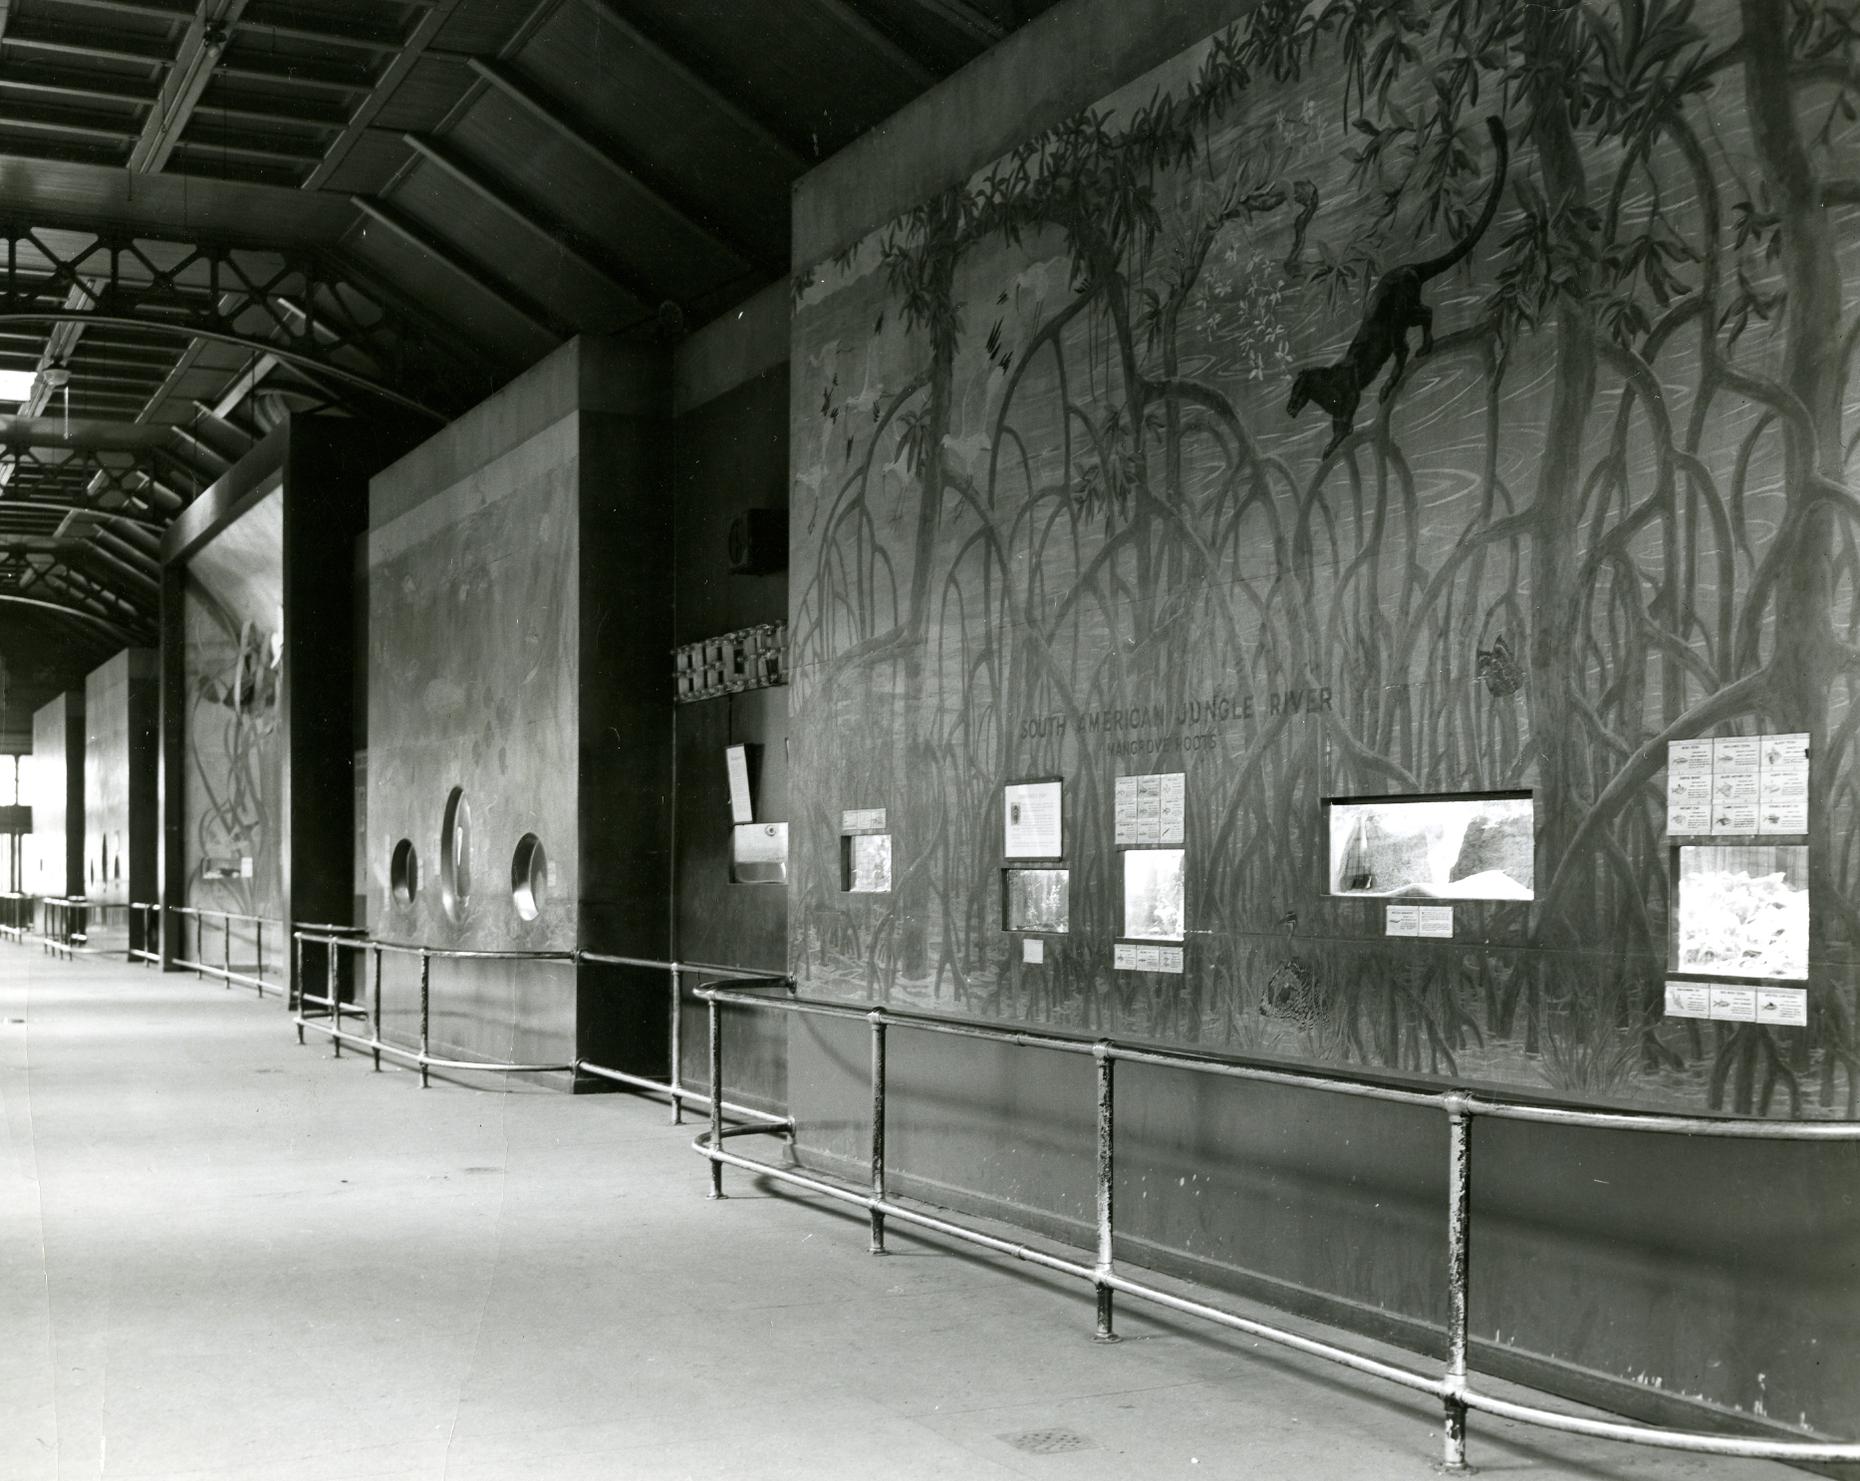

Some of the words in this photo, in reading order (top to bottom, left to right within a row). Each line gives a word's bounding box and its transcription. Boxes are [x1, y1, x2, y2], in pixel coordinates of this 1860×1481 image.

[1021, 716, 1066, 739] SOUTH
[1074, 704, 1164, 733] AMERICAN
[1177, 695, 1255, 725] JUNGLE
[1270, 687, 1333, 717] RIVER
